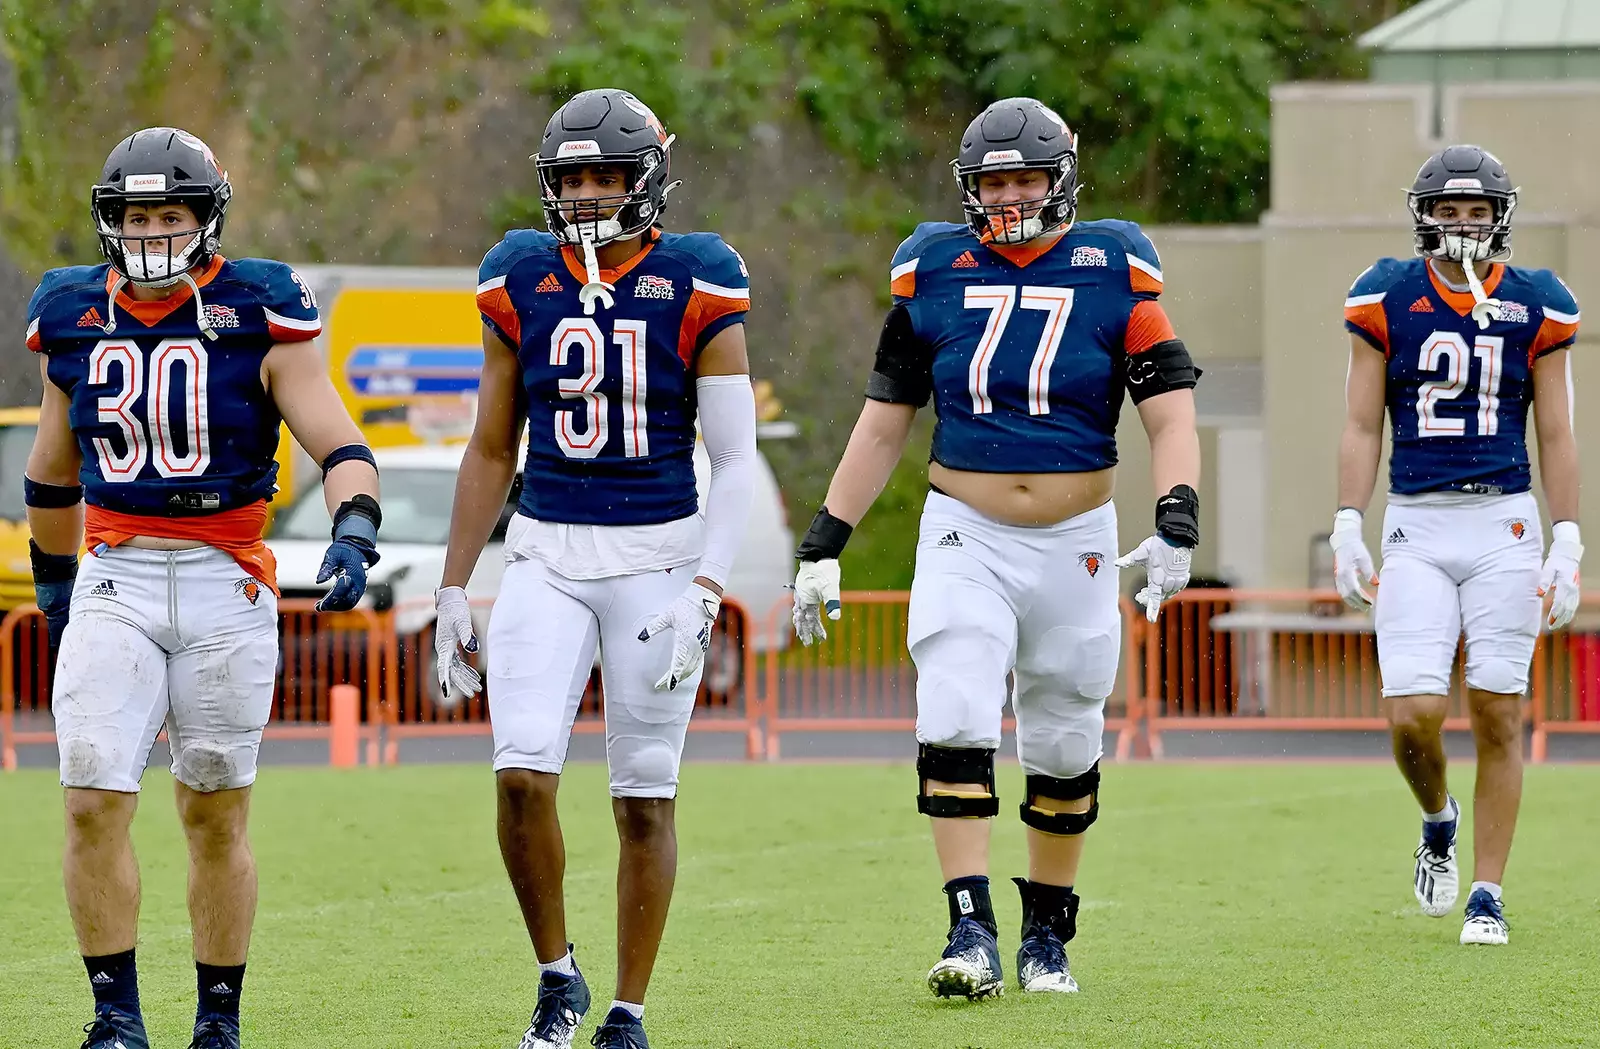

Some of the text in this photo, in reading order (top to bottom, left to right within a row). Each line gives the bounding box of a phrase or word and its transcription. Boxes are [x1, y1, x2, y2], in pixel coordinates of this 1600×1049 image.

[535, 284, 563, 293] adidas
[634, 291, 675, 300] LEAGUE
[963, 285, 1075, 416] 77
[87, 338, 211, 483] 30
[550, 317, 649, 459] 31
[1416, 330, 1504, 438] 21
[937, 539, 963, 548] adidas
[90, 587, 118, 597] adidas
